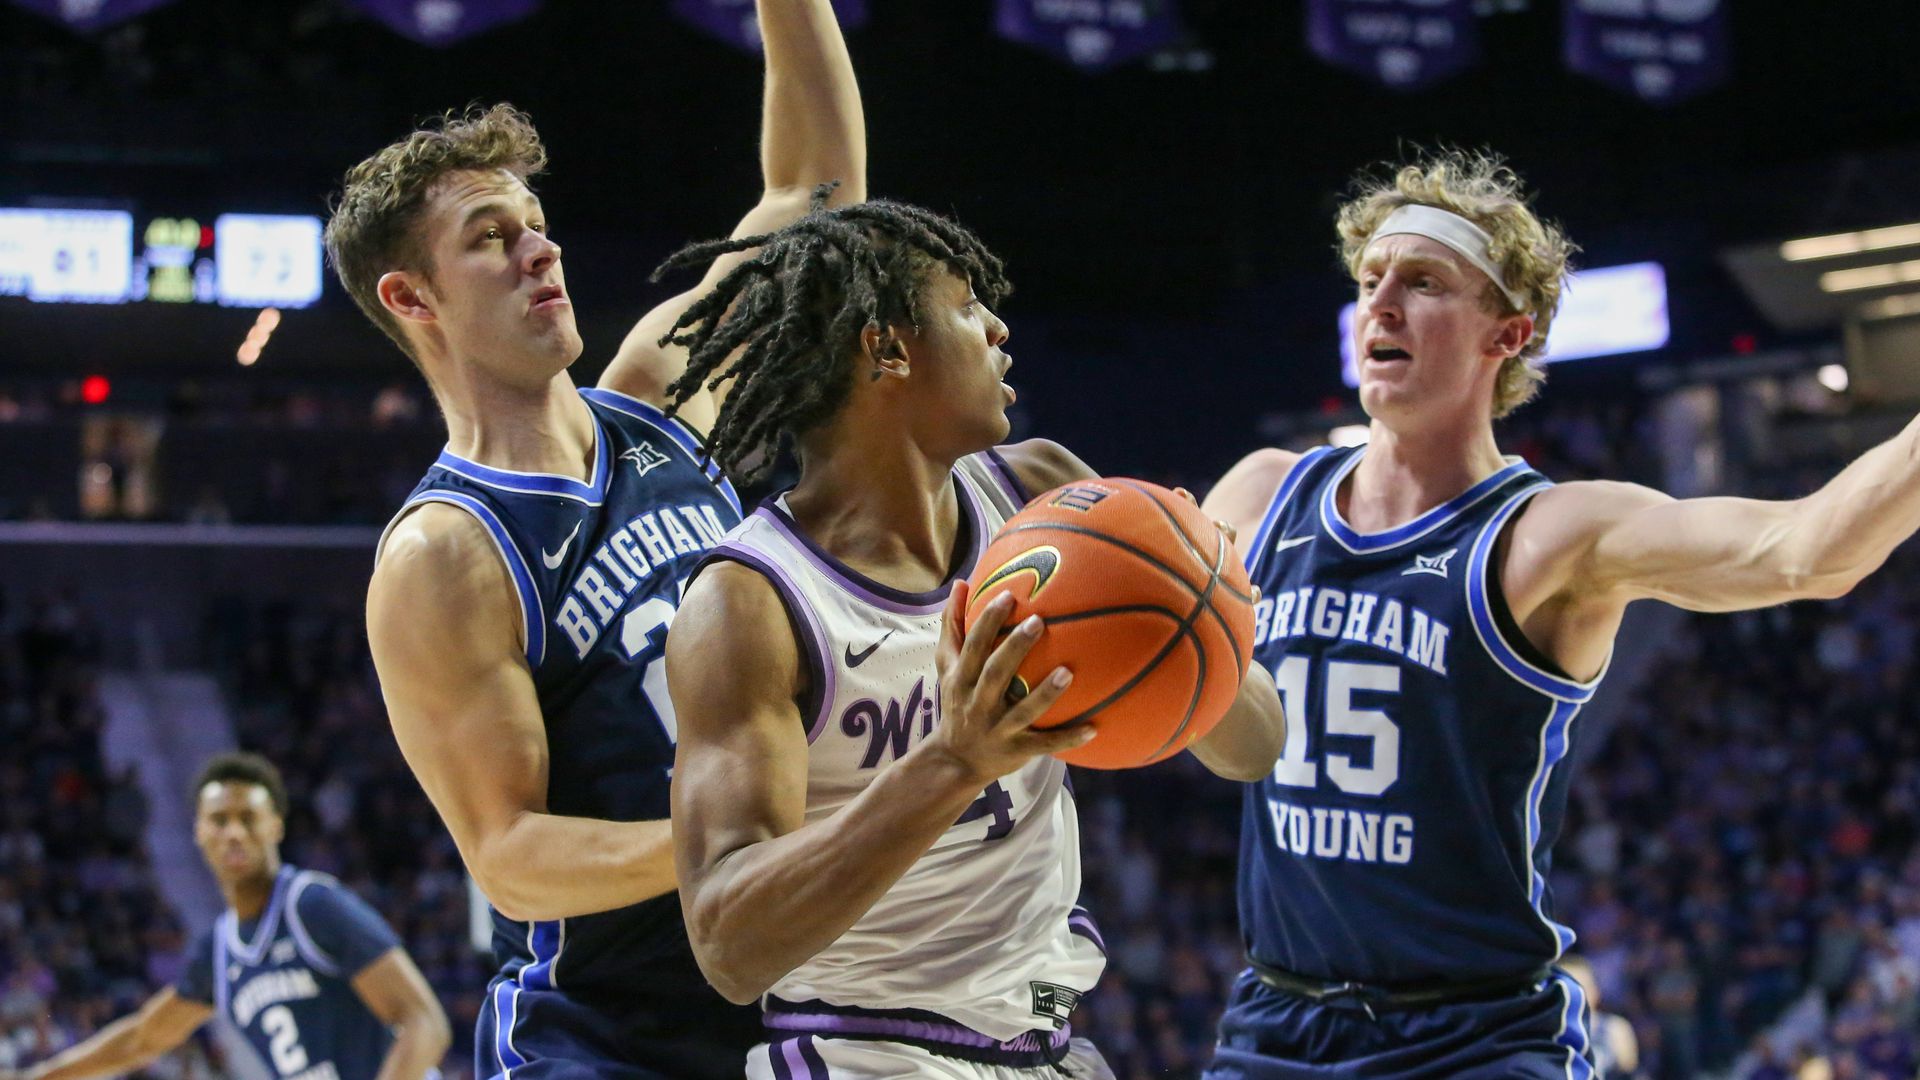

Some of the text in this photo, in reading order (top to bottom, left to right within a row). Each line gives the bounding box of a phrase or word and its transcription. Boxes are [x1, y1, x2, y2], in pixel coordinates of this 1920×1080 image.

[554, 504, 728, 661] BRIGHAM
[1254, 584, 1450, 676] BRIGHAM
[840, 675, 942, 770] Wi
[1274, 655, 1401, 796] 15
[1267, 798, 1415, 865] YOUNG
[261, 1004, 309, 1076] 2
